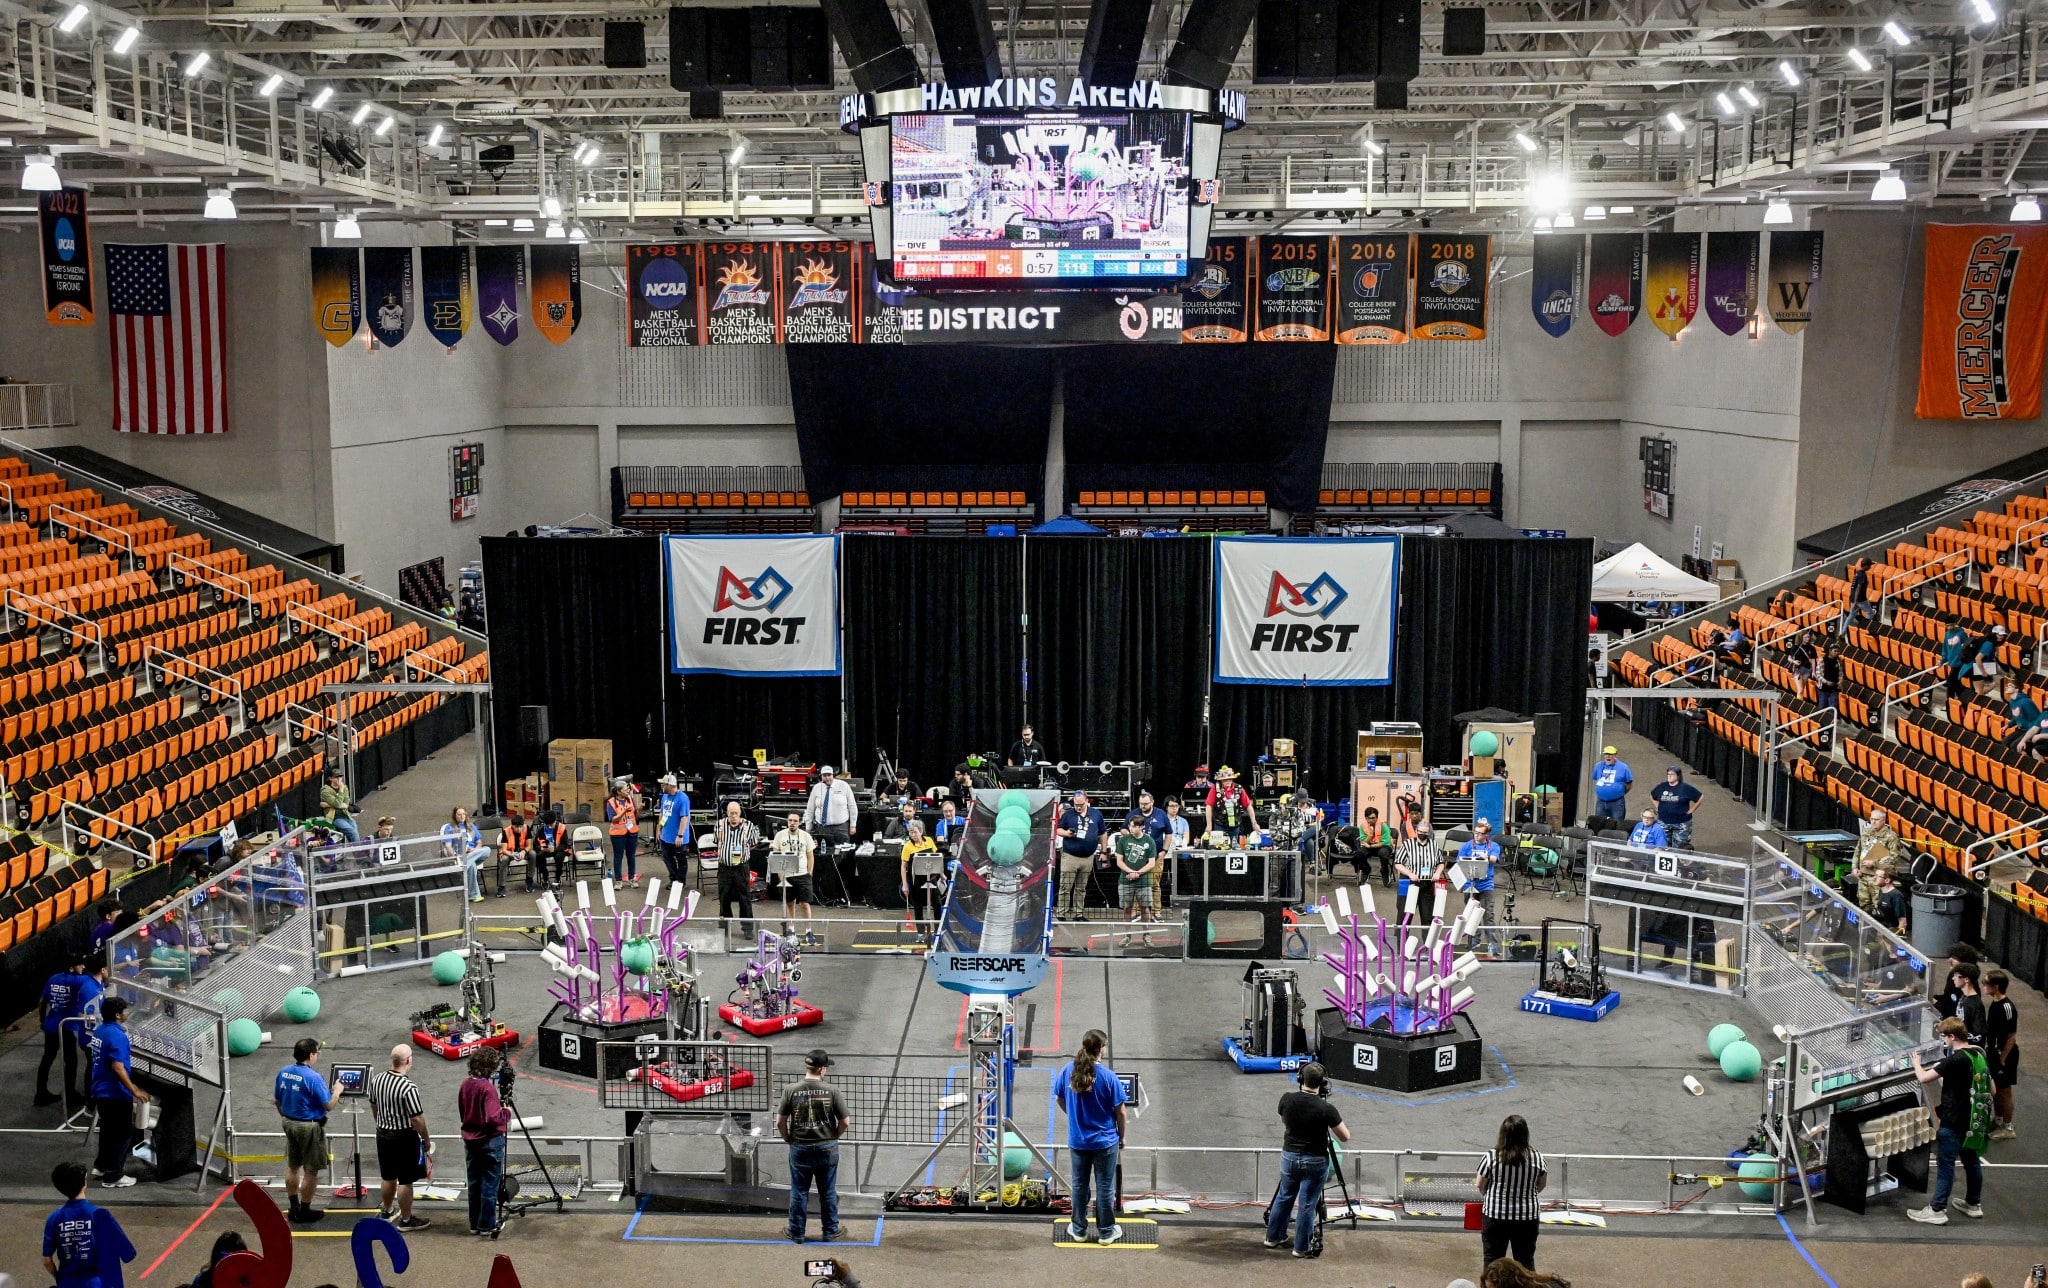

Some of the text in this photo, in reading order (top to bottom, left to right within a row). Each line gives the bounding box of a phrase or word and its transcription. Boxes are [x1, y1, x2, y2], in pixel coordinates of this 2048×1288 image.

[921, 77, 1165, 111] HAWKINS ARENA
[48, 192, 79, 214] 2022
[634, 246, 692, 257] 1981
[711, 243, 769, 254] 1981
[788, 242, 849, 254] 1985
[1271, 243, 1317, 261] 2015
[1351, 243, 1396, 260] 2016
[1431, 243, 1475, 260] 2018
[1632, 239, 1640, 281] SAMFORD
[1812, 238, 1820, 279] WOFFORD
[996, 263, 1013, 275] 96
[1026, 263, 1054, 274] 0:57
[1438, 264, 1463, 279] CBI
[404, 253, 412, 303] THE CITADEL
[1688, 240, 1698, 314] VIRGINIA MILITARY
[645, 282, 687, 297] NCAA
[1777, 281, 1813, 309] W
[803, 307, 833, 316] MEN'S
[1186, 307, 1237, 315] INVITATIONAL
[1267, 305, 1318, 313] INVITATIONAL
[1424, 303, 1475, 311] INVITATIONAL
[1542, 297, 1573, 315] UNCG
[1597, 305, 1635, 313] SAMFORD
[1714, 296, 1748, 317] WCU
[650, 310, 679, 319] MEN'S
[726, 308, 756, 318] MEN'S
[929, 307, 1061, 330] DISTRICT
[634, 319, 697, 328] BASKETBALL
[710, 317, 774, 326] BASKETBALL
[786, 316, 850, 325] BASKETBALL
[1958, 235, 2013, 417] MERCER
[1993, 268, 2012, 384] BEARS
[642, 328, 687, 337] MIDWEST
[706, 326, 776, 335] TOURNAMENT
[783, 325, 853, 334] TOURNAMENT
[640, 336, 691, 346] REGIONAL
[712, 335, 772, 344] CHAMPIONS
[788, 334, 848, 344] CHAMPIONS
[1636, 592, 1660, 600] Georgia
[703, 617, 806, 646] FIRST
[1250, 624, 1360, 653] FIRST
[951, 957, 1025, 972] REEFSCAPE
[50, 984, 71, 993] 1261
[1523, 1000, 1551, 1013] 1771
[782, 1017, 798, 1029] 9480
[704, 1082, 723, 1096] 832
[798, 1089, 825, 1097] PROUD
[58, 1219, 92, 1232] 1261
